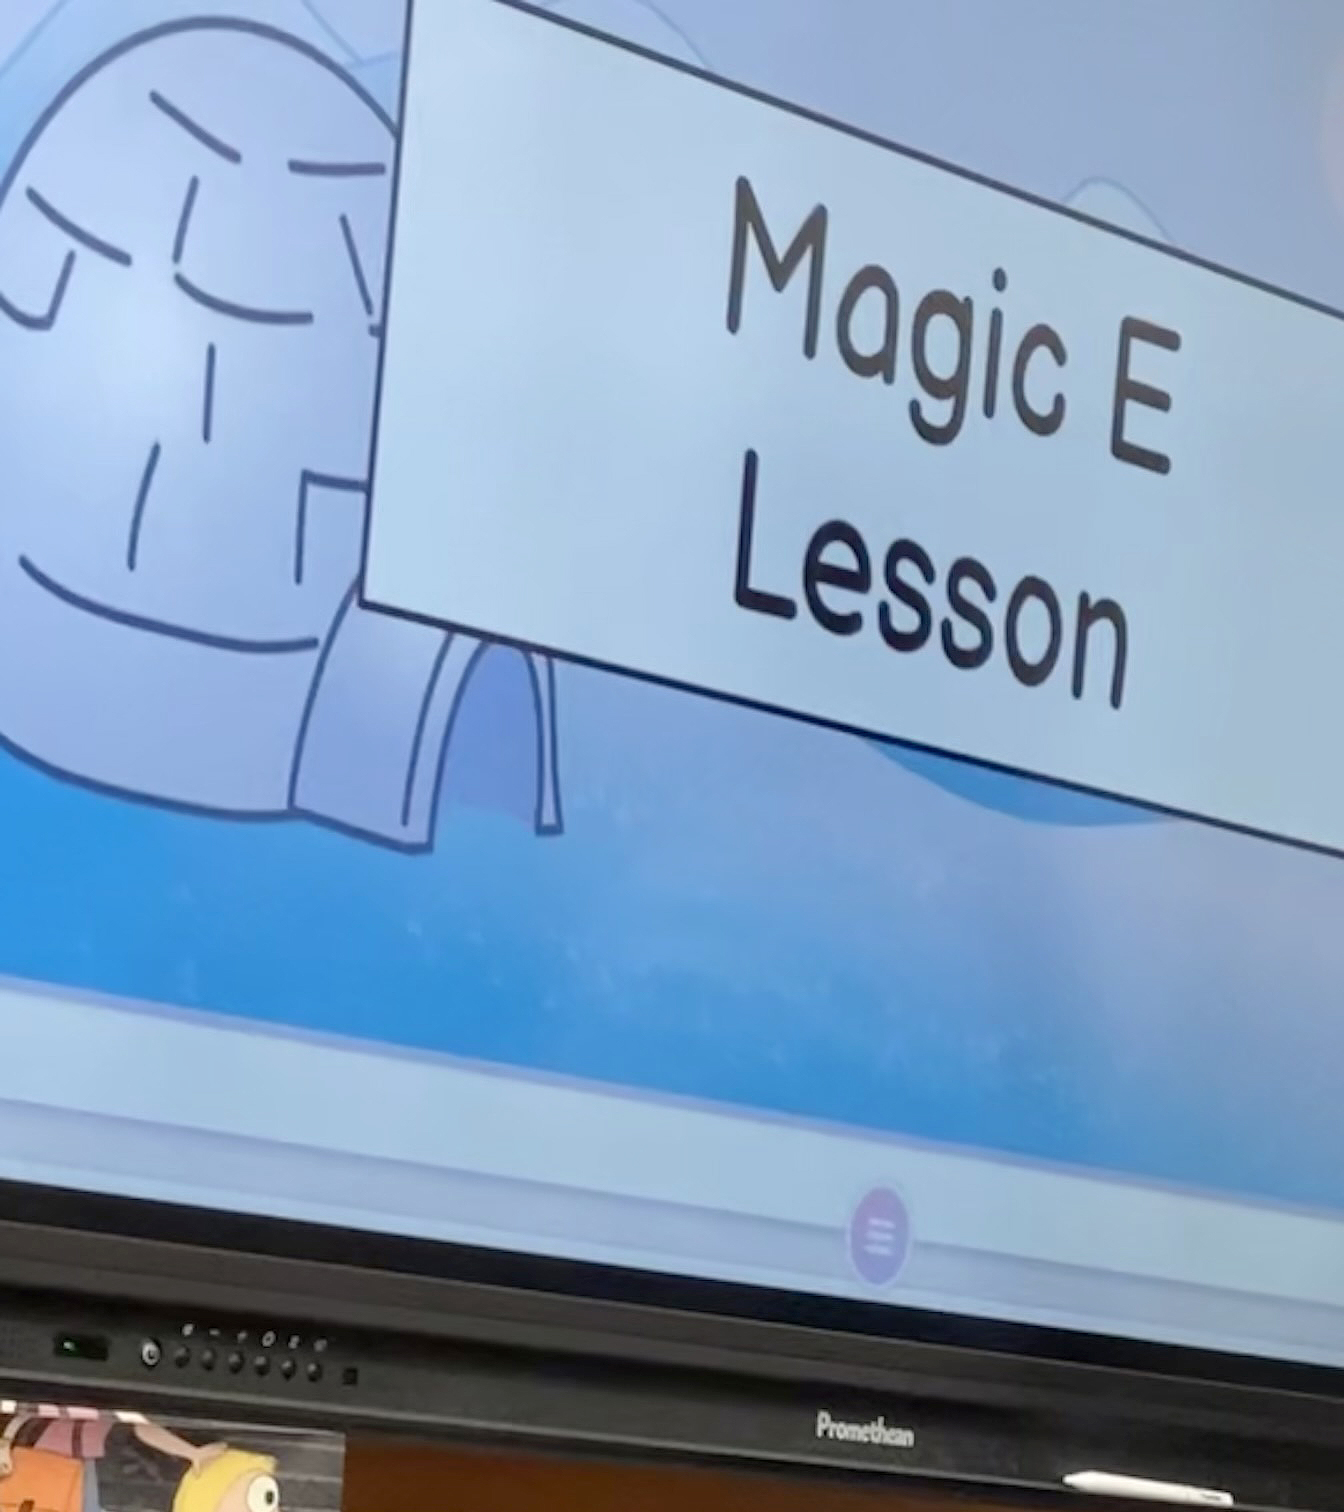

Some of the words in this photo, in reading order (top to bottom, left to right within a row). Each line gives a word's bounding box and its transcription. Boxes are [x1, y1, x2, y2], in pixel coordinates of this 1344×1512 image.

[727, 175, 1066, 446] Magic
[1111, 316, 1181, 475] E
[733, 449, 1128, 710] Lesson
[815, 1410, 915, 1449] Promethean
